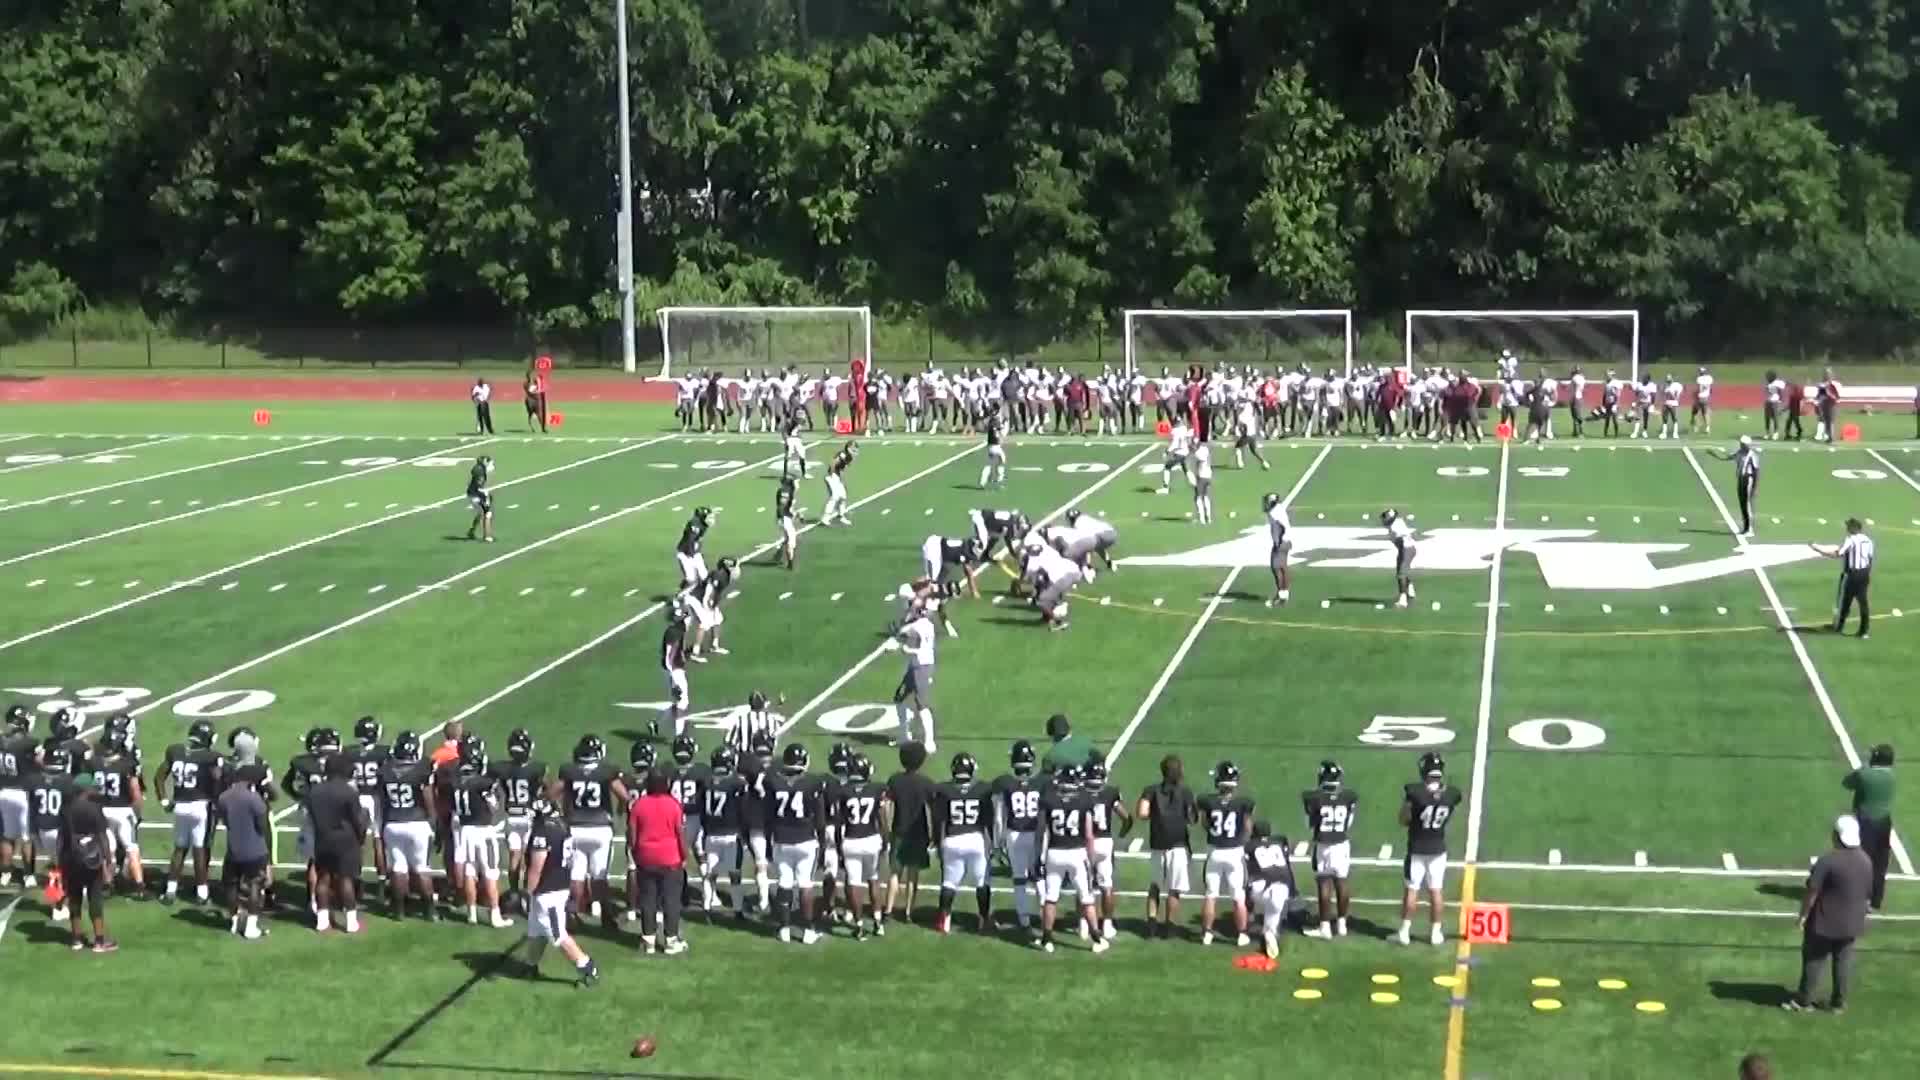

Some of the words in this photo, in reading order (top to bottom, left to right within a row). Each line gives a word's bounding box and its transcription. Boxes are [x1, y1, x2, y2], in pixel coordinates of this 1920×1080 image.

[36, 686, 277, 717] 30
[1358, 715, 1606, 750] 50
[35, 788, 62, 816] 30
[386, 782, 416, 808] 52
[454, 788, 472, 816] 11
[505, 779, 530, 803] 16
[572, 781, 601, 808] 73
[671, 780, 697, 804] 42
[705, 789, 727, 816] 17
[775, 791, 804, 818] 74
[846, 797, 875, 825] 37
[950, 799, 980, 826] 55
[1051, 809, 1080, 836] 24
[1210, 810, 1237, 838] 34
[1319, 804, 1348, 832] 29
[1420, 804, 1449, 829] 48
[1471, 911, 1503, 938] 50
